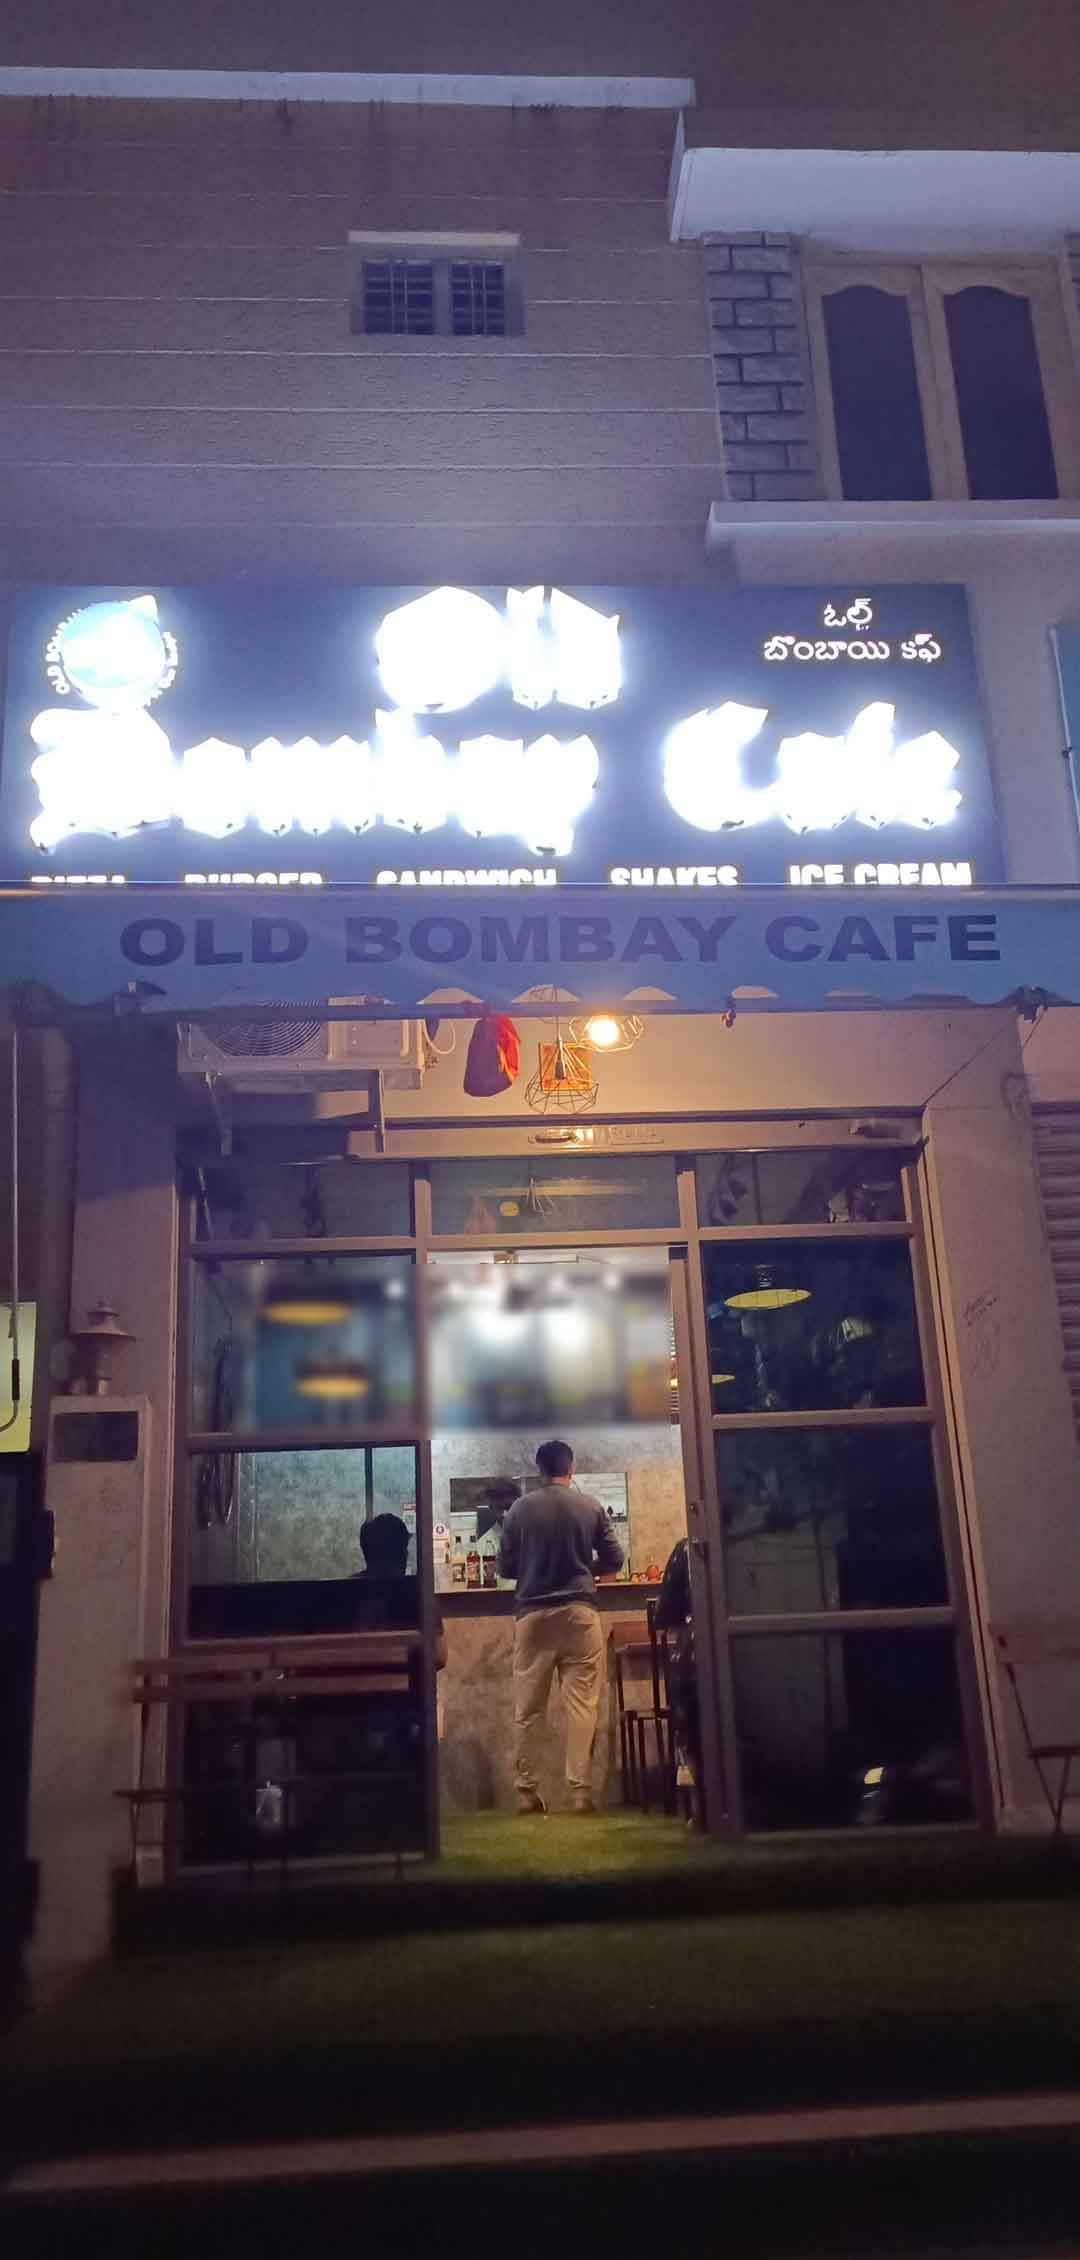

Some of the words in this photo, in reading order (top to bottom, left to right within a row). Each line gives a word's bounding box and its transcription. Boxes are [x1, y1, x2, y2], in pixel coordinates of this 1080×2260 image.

[789, 863, 844, 887] ICE
[853, 861, 972, 887] CREAM
[119, 917, 309, 966] OLD
[345, 914, 737, 964] BOMBAY
[764, 914, 1001, 962] CAFE
